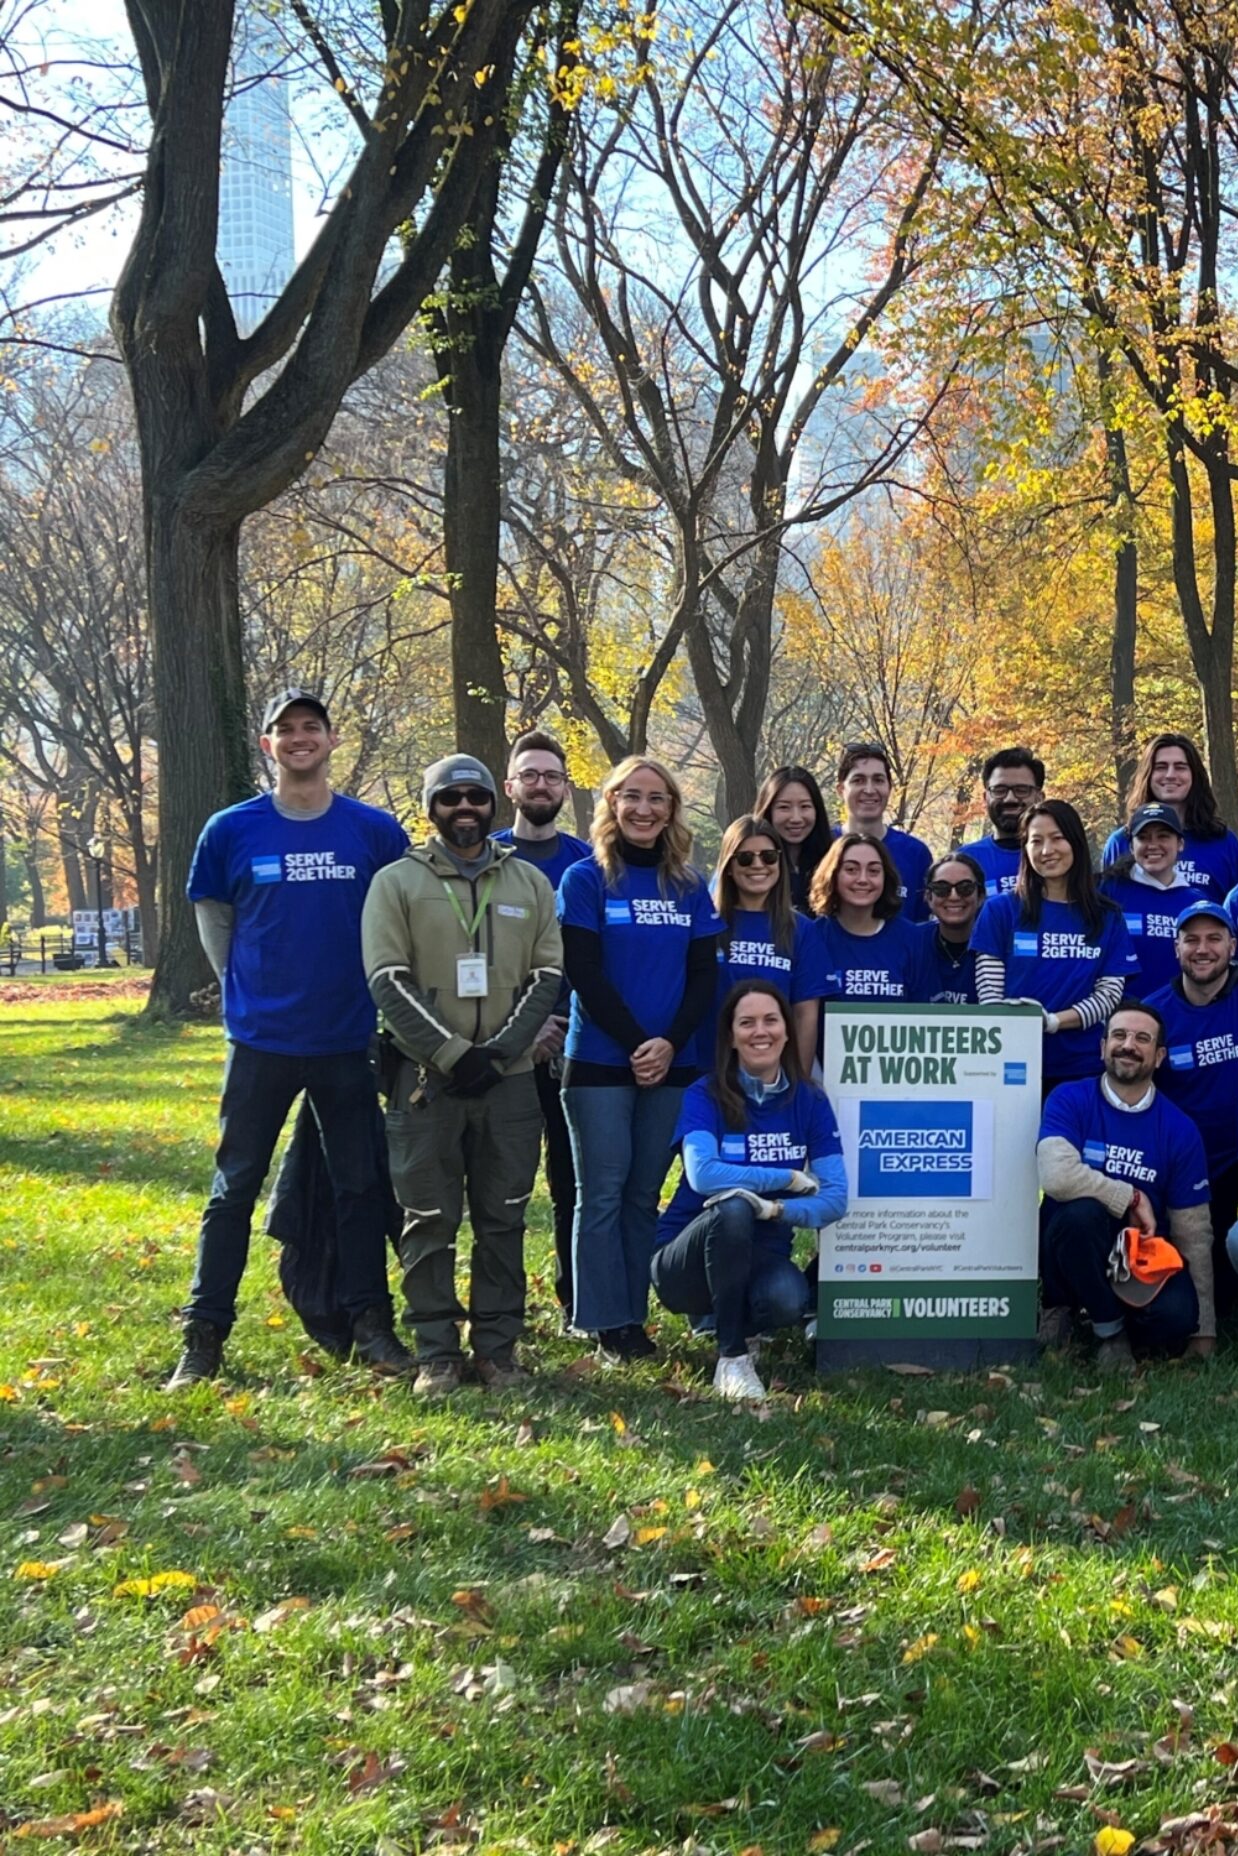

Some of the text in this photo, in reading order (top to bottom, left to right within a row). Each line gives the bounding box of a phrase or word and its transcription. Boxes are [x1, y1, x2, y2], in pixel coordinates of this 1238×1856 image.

[285, 852, 334, 867] SERVE
[287, 866, 356, 881] 2GETHER
[632, 899, 677, 912] SERVE
[1146, 914, 1178, 927] SERV
[1042, 932, 1085, 946] SERVE
[1146, 925, 1177, 939] 2GET
[729, 941, 775, 955] SERVE
[1042, 945, 1101, 959] 2GETHER
[729, 953, 791, 971] 2GETHER
[845, 970, 889, 982] SERVE
[944, 991, 968, 1004] RVE
[841, 1024, 1002, 1054] VOLUNTEERS
[1195, 1034, 1234, 1054] SERVE
[840, 1056, 957, 1084] AT WORK
[748, 1132, 792, 1148] SERVE
[859, 1131, 964, 1147] AMERICAN
[750, 1145, 807, 1162] 2GETHER
[882, 1155, 972, 1170] EXPRESS
[1105, 1161, 1157, 1183] GETHER
[877, 1210, 925, 1218] information
[928, 1210, 952, 1218] about
[954, 1210, 969, 1218] the
[835, 1221, 950, 1231] Central Park Conservancy's
[835, 1232, 966, 1242] Volunteer Program, please visit
[835, 1243, 962, 1253] centralparknyc.org/volunteer
[833, 1298, 892, 1309] CENTRAL PARK
[903, 1297, 1010, 1318] VOLUNTEERS
[833, 1308, 891, 1319] CONSERVANCY
